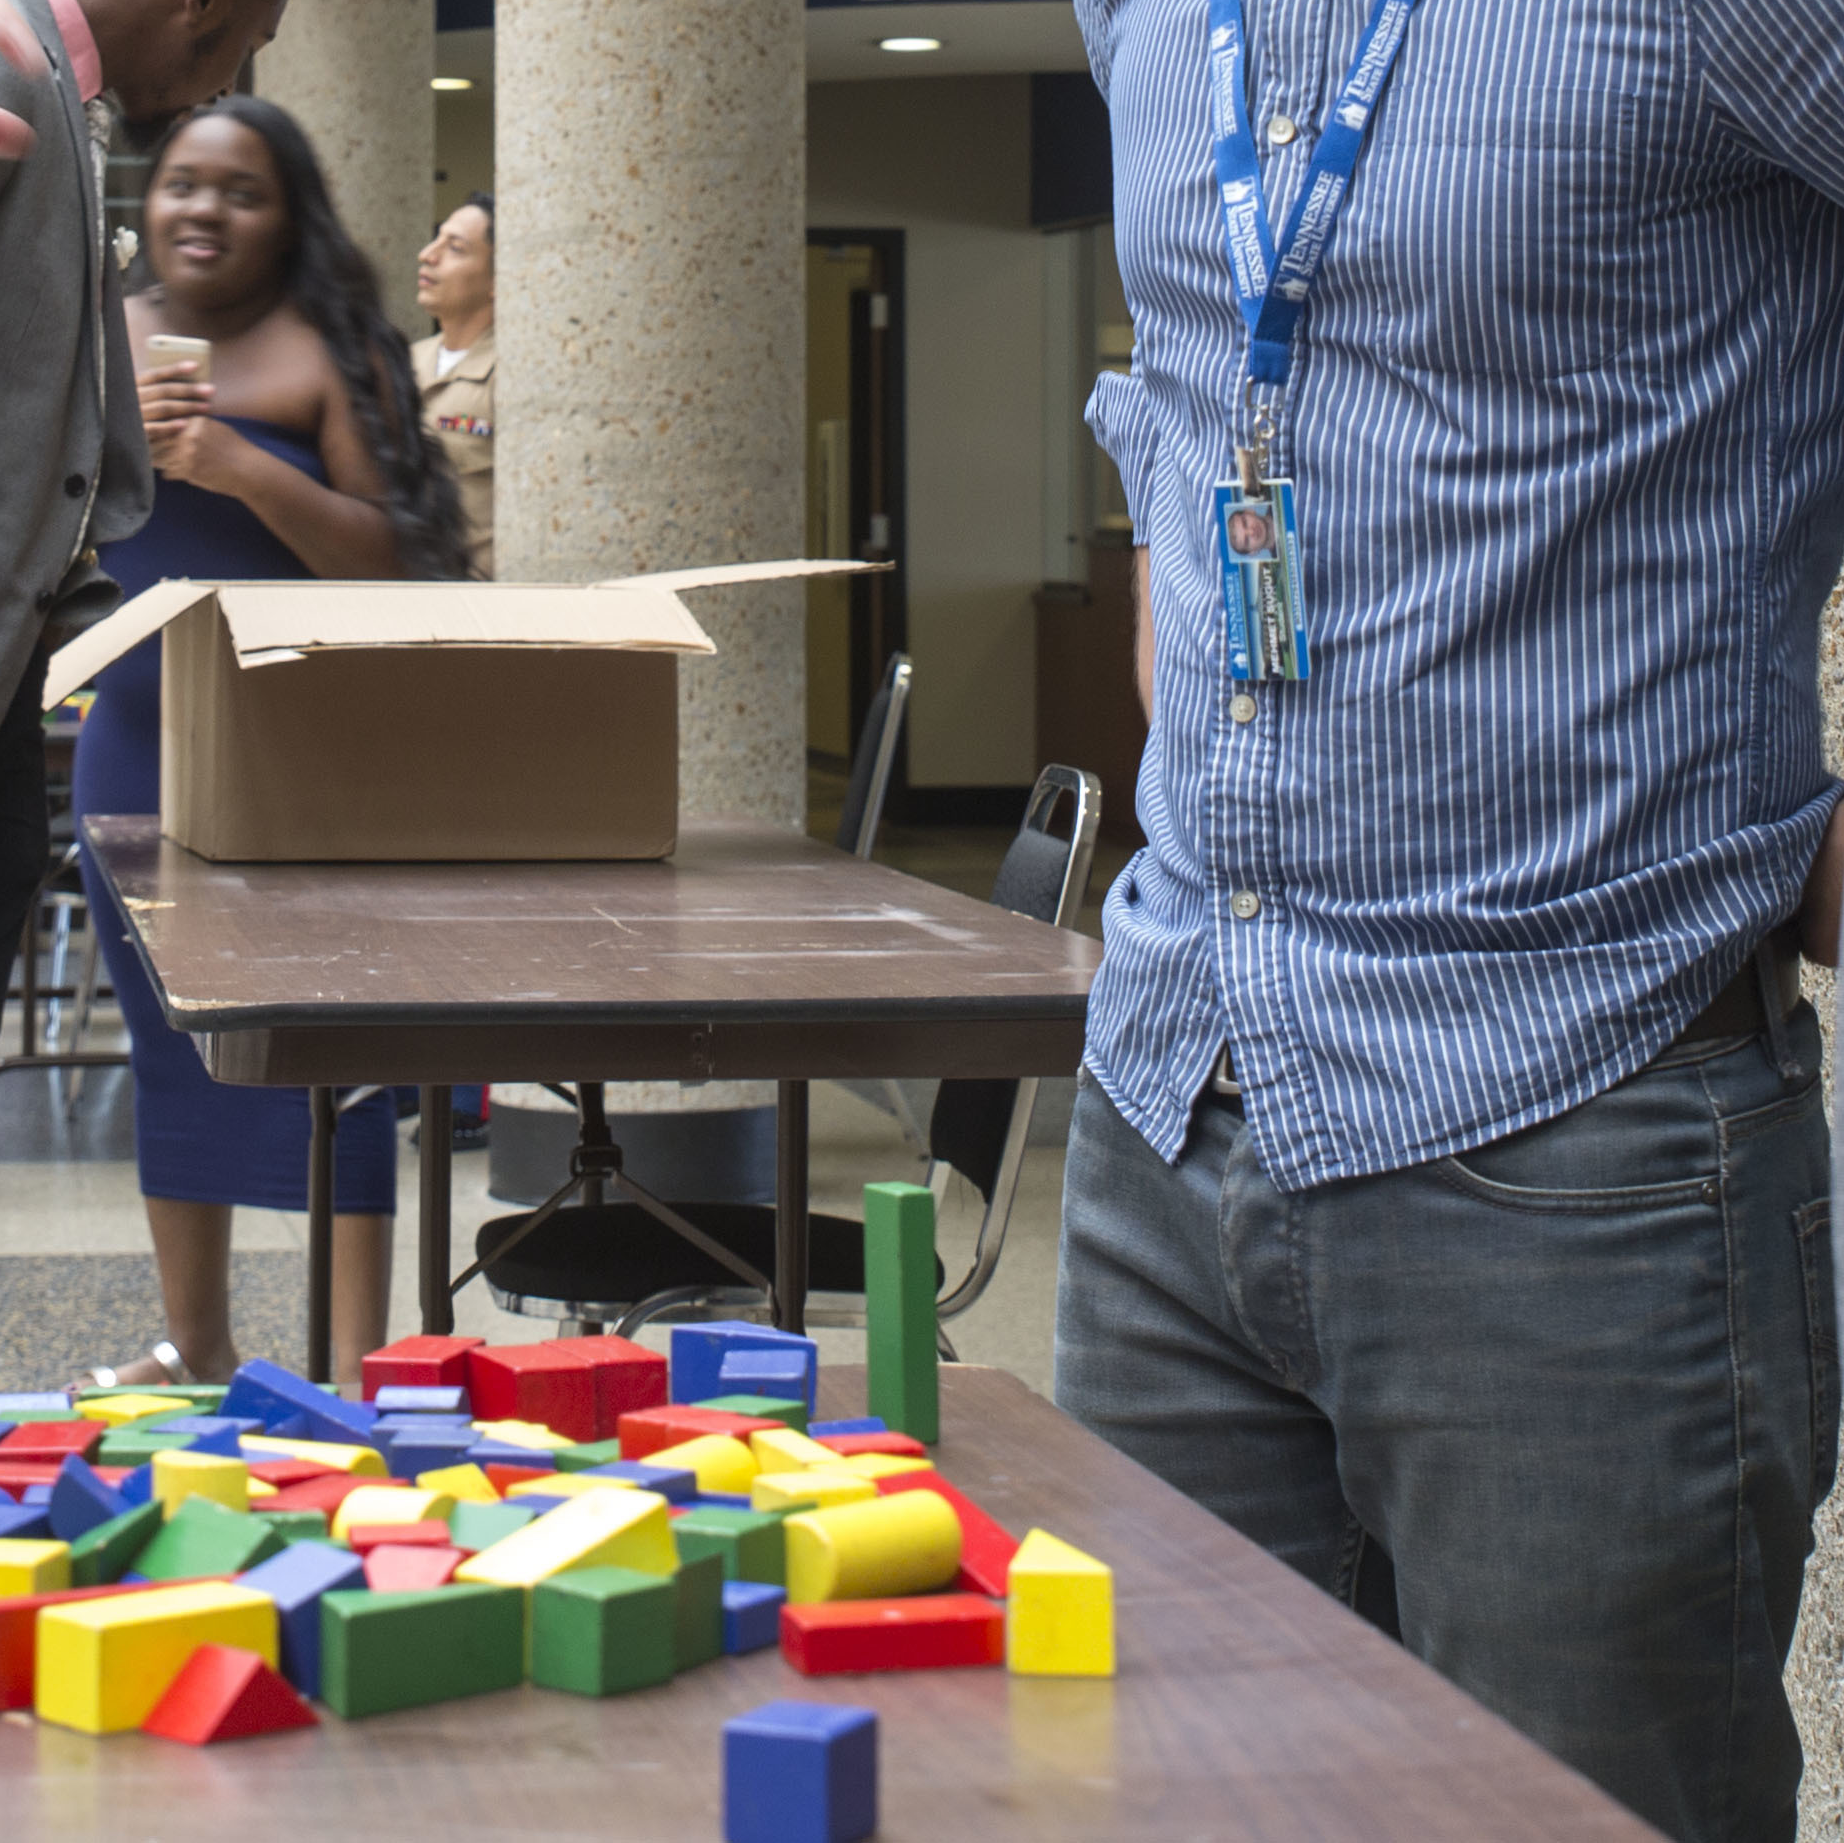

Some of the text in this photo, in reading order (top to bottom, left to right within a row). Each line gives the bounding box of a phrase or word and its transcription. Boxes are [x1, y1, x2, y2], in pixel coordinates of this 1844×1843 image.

[1213, 42, 1239, 137] TENNESSEE
[1360, 68, 1383, 103] STATE
[1230, 236, 1252, 298] UNIVERSITY
[1237, 196, 1269, 297] TENNESSEE
[1279, 170, 1333, 272] TENNESSEE
[1300, 175, 1344, 276] STATE UNIVERSITY
[1267, 616, 1280, 674] MEHMET
